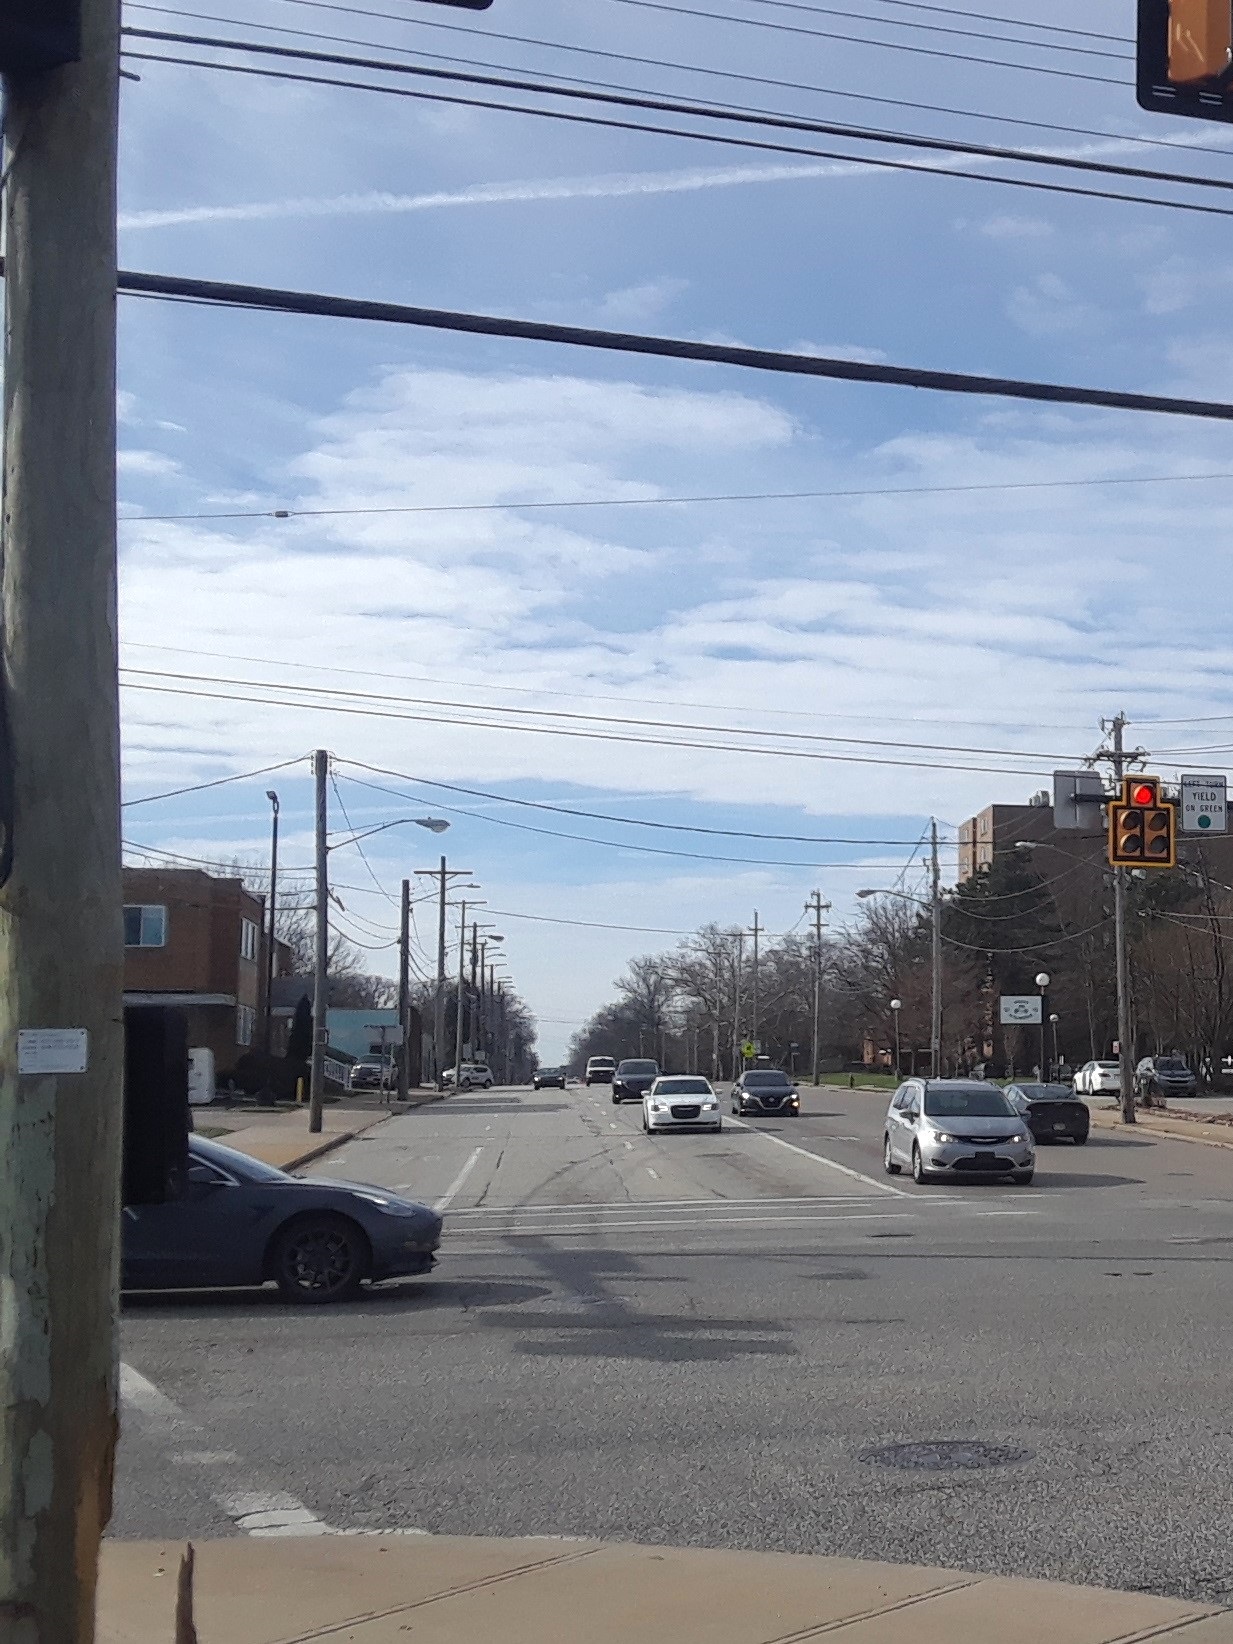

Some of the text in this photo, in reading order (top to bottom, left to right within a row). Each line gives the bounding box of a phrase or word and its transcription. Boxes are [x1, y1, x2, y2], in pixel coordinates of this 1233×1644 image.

[1192, 792, 1217, 801] YIELD
[1185, 804, 1223, 812] ON GREEN
